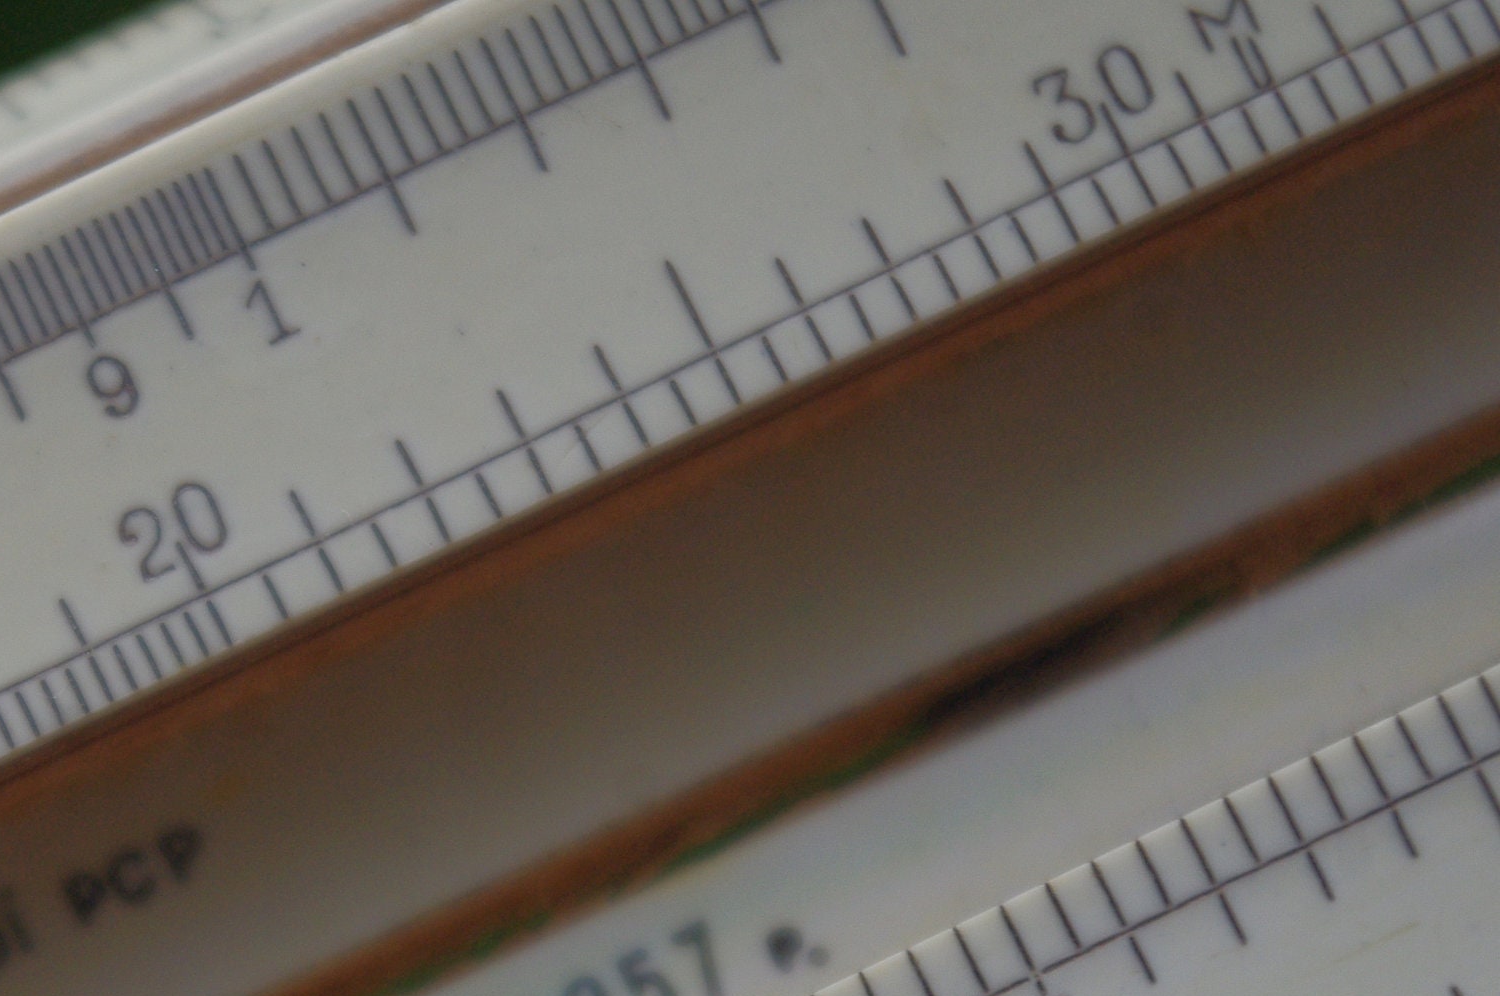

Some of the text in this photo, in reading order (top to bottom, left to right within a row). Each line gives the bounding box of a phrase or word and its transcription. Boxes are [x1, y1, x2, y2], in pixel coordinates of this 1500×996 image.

[86, 355, 140, 418] 9
[245, 279, 300, 345] 1
[118, 482, 227, 582] 20
[1031, 43, 1156, 144] 30
[60, 823, 202, 924] РСР
